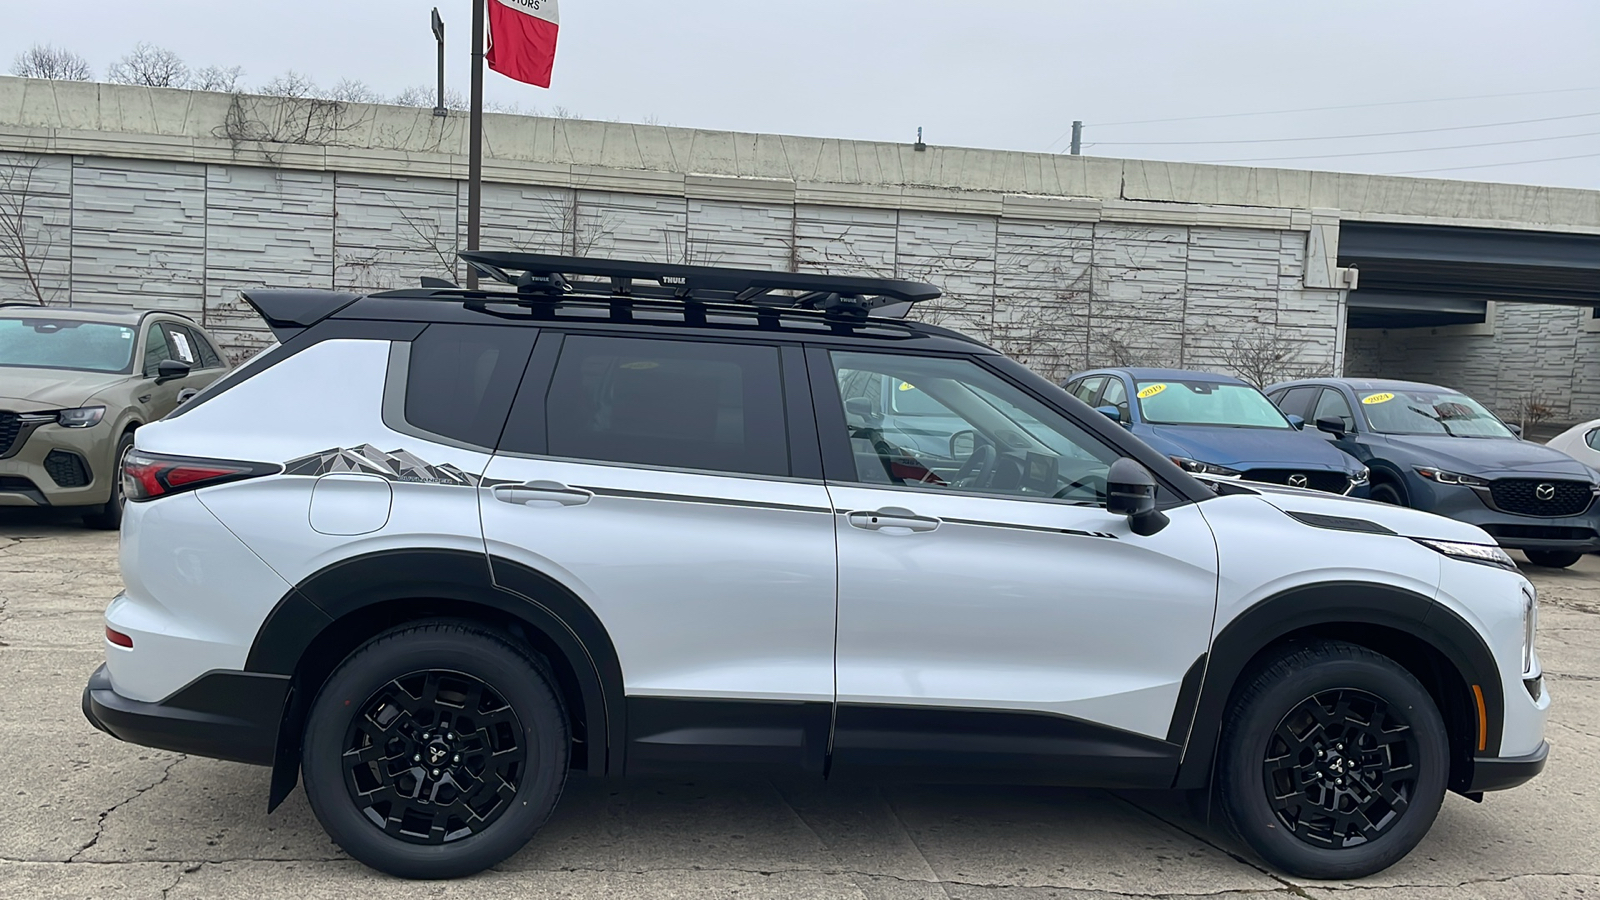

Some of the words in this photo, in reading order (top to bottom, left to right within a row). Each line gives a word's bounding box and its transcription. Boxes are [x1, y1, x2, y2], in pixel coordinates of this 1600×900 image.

[512, 0, 540, 10] ORS
[663, 276, 686, 284] THULE
[1142, 385, 1162, 396] 2019
[1369, 393, 1389, 403] 2024
